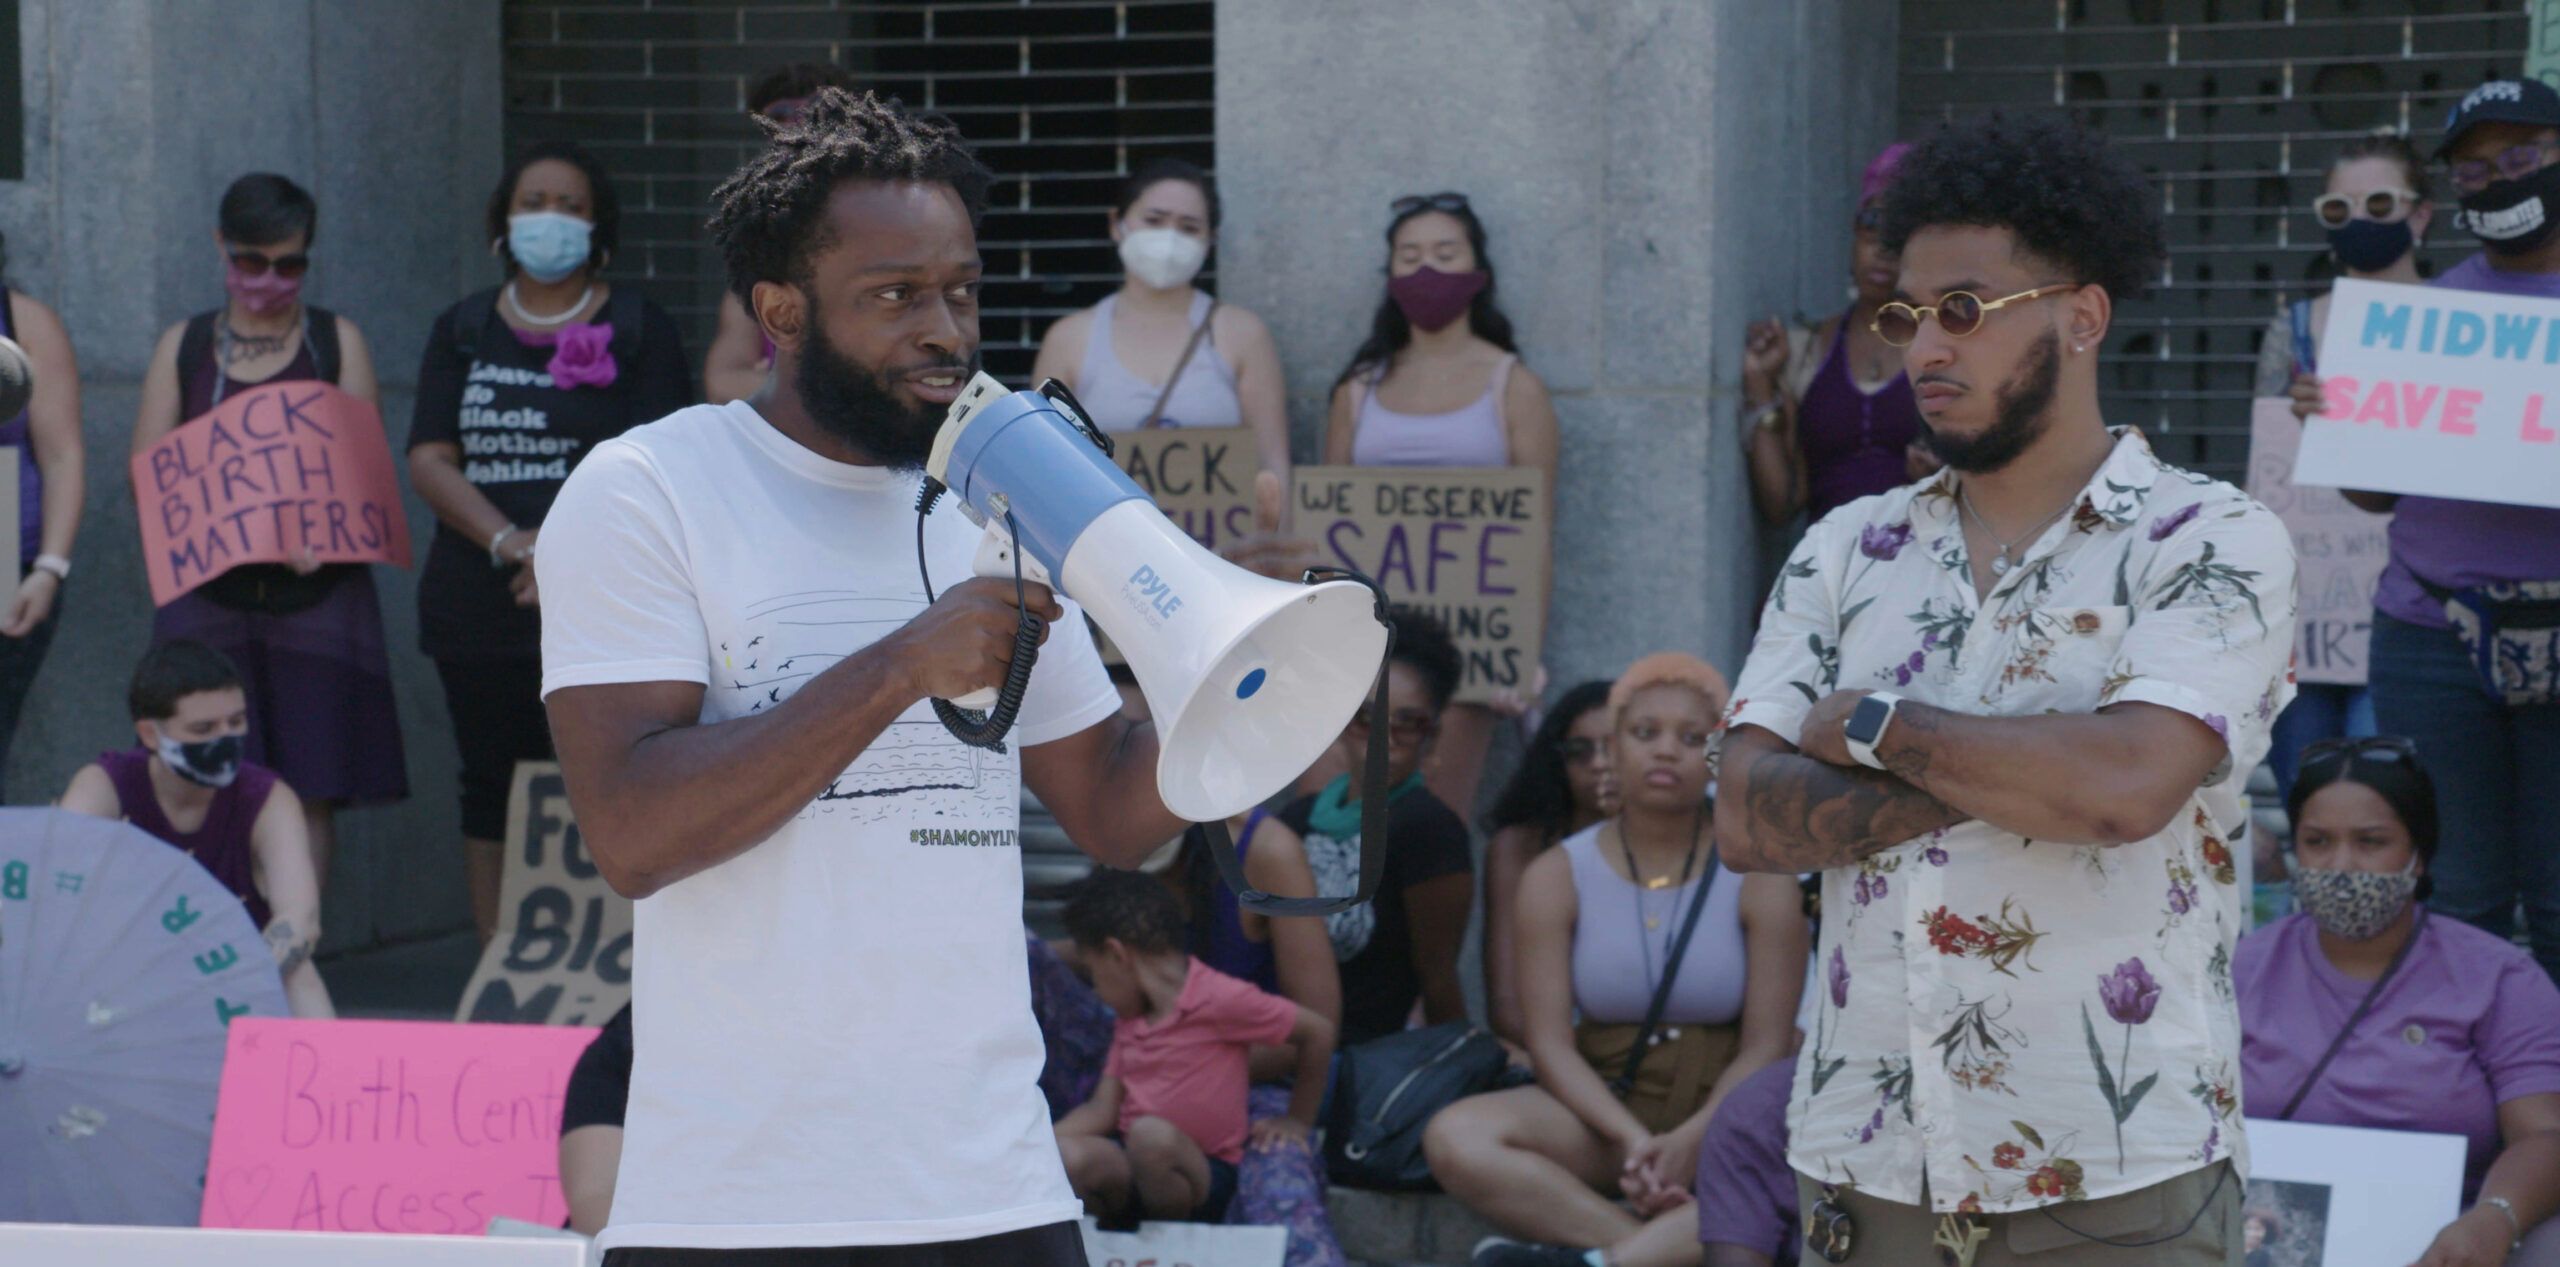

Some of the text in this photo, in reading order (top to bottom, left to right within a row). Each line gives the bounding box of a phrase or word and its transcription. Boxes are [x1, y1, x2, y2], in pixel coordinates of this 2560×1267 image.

[2361, 301, 2560, 366] MIDWI
[2318, 375, 2484, 436] SAVE
[152, 389, 335, 493] BLACK
[1126, 440, 1239, 495] ACK
[160, 442, 335, 540] BIRTH
[1302, 482, 1533, 520] WE DESERVE
[169, 500, 393, 588] MATTERS!
[1326, 519, 1523, 596] SAFE
[1129, 564, 1184, 620] PYLE
[910, 828, 1021, 847] #SHAMONYLIV
[282, 1041, 565, 1149] Birth Cent
[292, 1170, 485, 1235] Access
